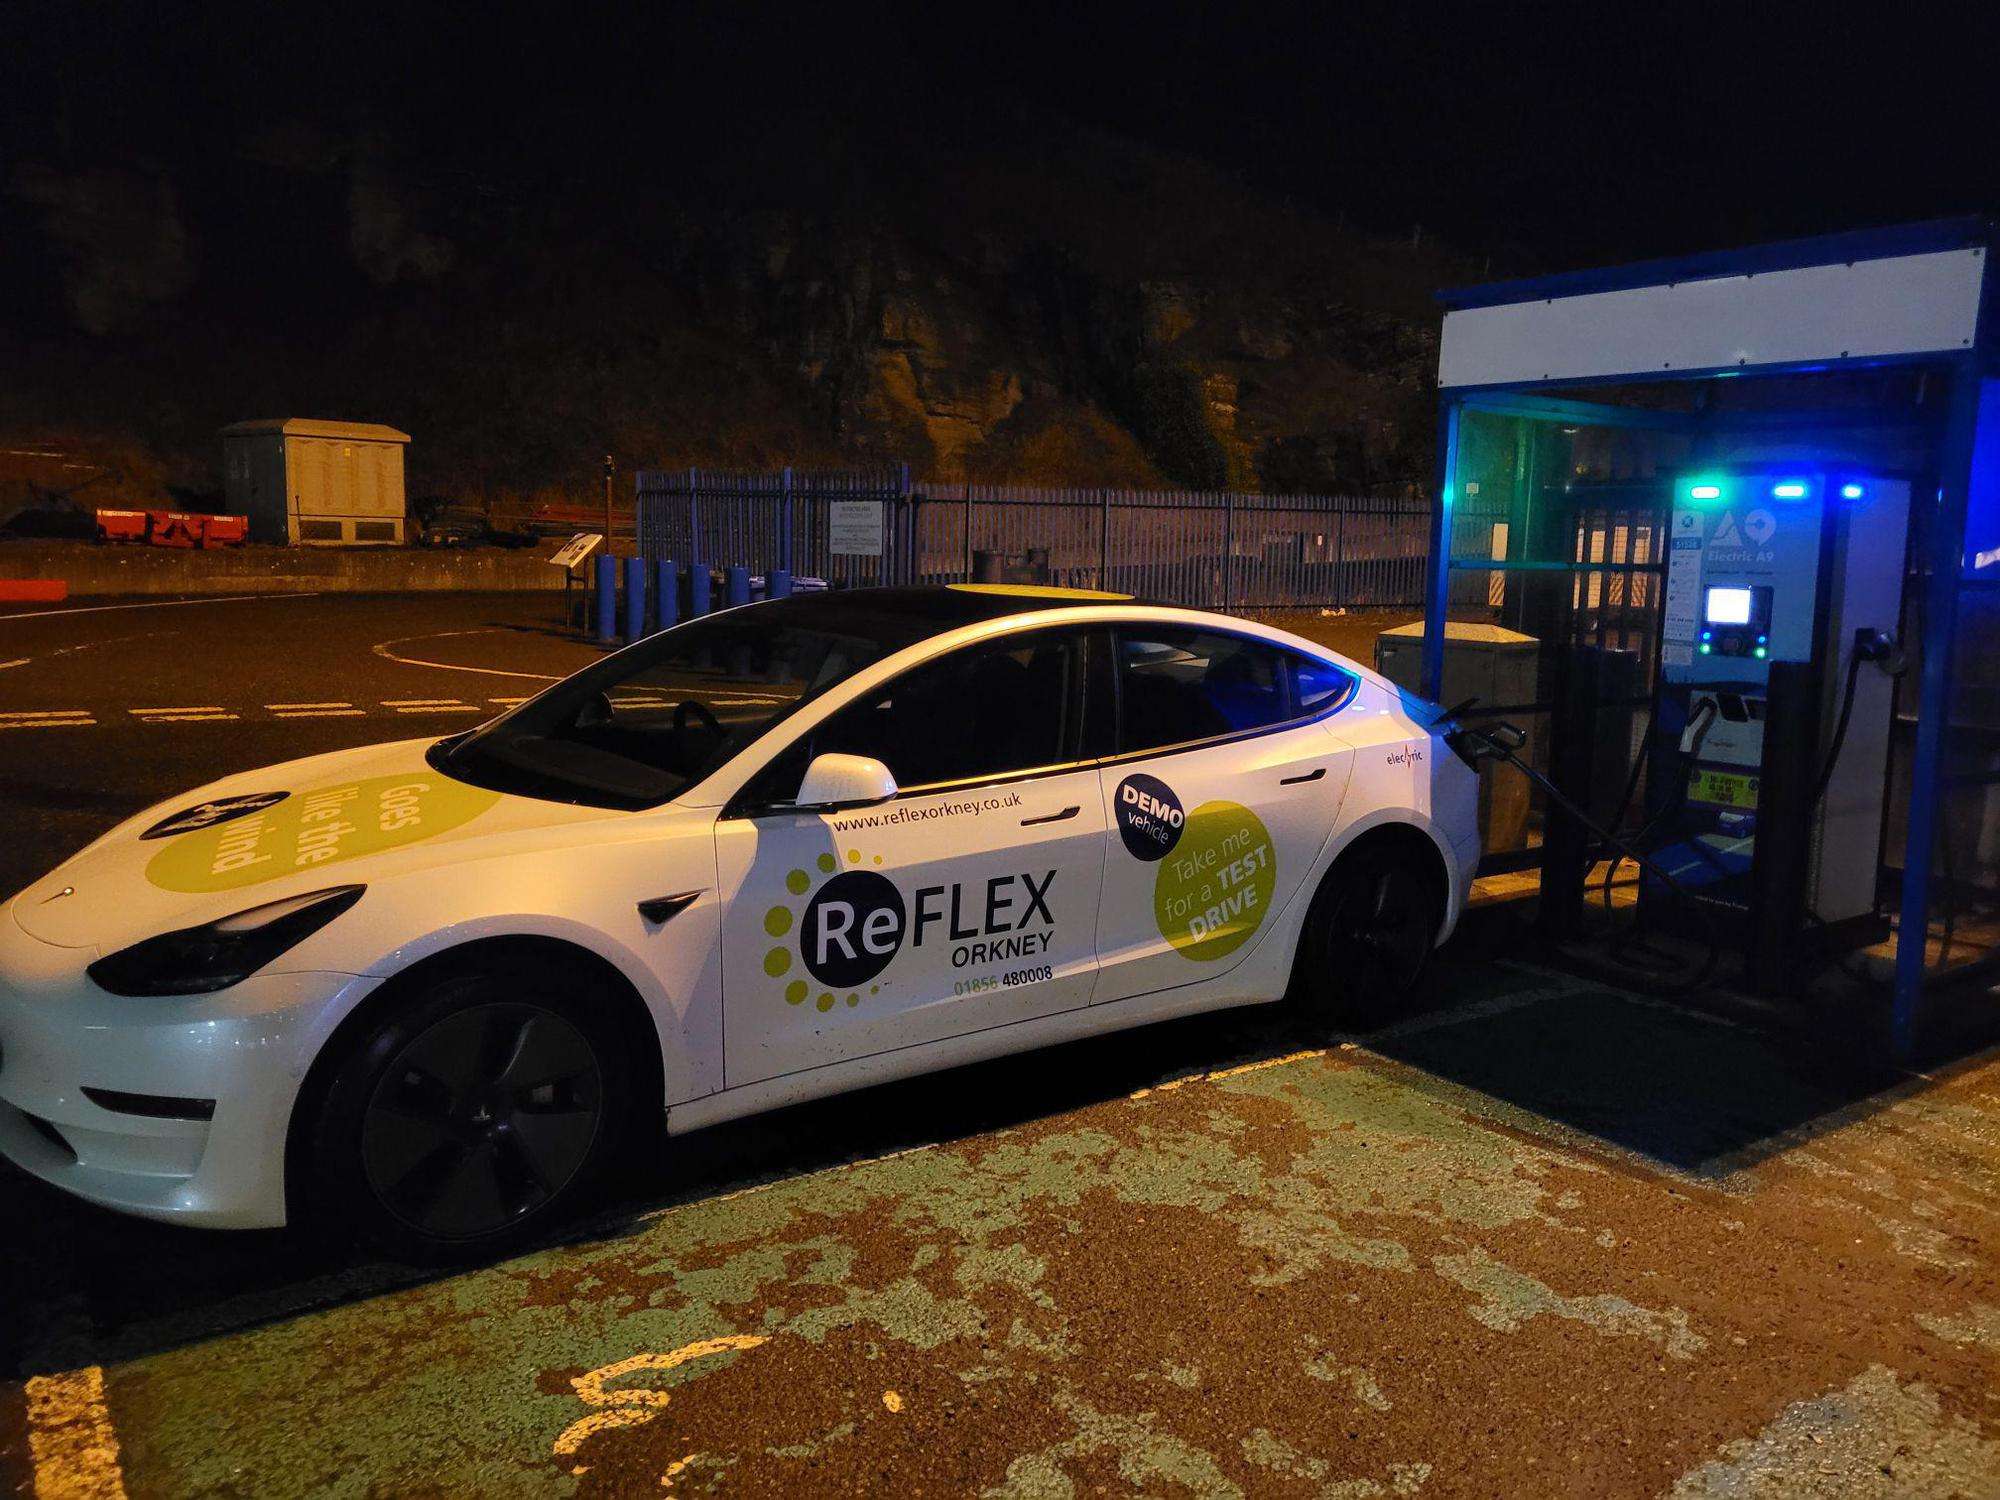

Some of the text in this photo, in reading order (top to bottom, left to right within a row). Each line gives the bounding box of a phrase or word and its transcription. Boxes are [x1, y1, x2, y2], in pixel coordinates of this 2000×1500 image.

[1708, 551, 1775, 562] Electric A9
[295, 786, 359, 866] like the
[379, 783, 430, 832] Goes
[833, 792, 1022, 832] www.reflexorkney.co.uk
[1122, 784, 1183, 829] DEMO
[1128, 811, 1169, 845] vehicle
[211, 815, 277, 875] wind
[1172, 827, 1250, 884] Take me
[1164, 844, 1267, 922] for a TEST
[1188, 884, 1258, 943] DRIVE
[951, 930, 1054, 968] ORKNEY
[953, 965, 1054, 997] 01856 480008
